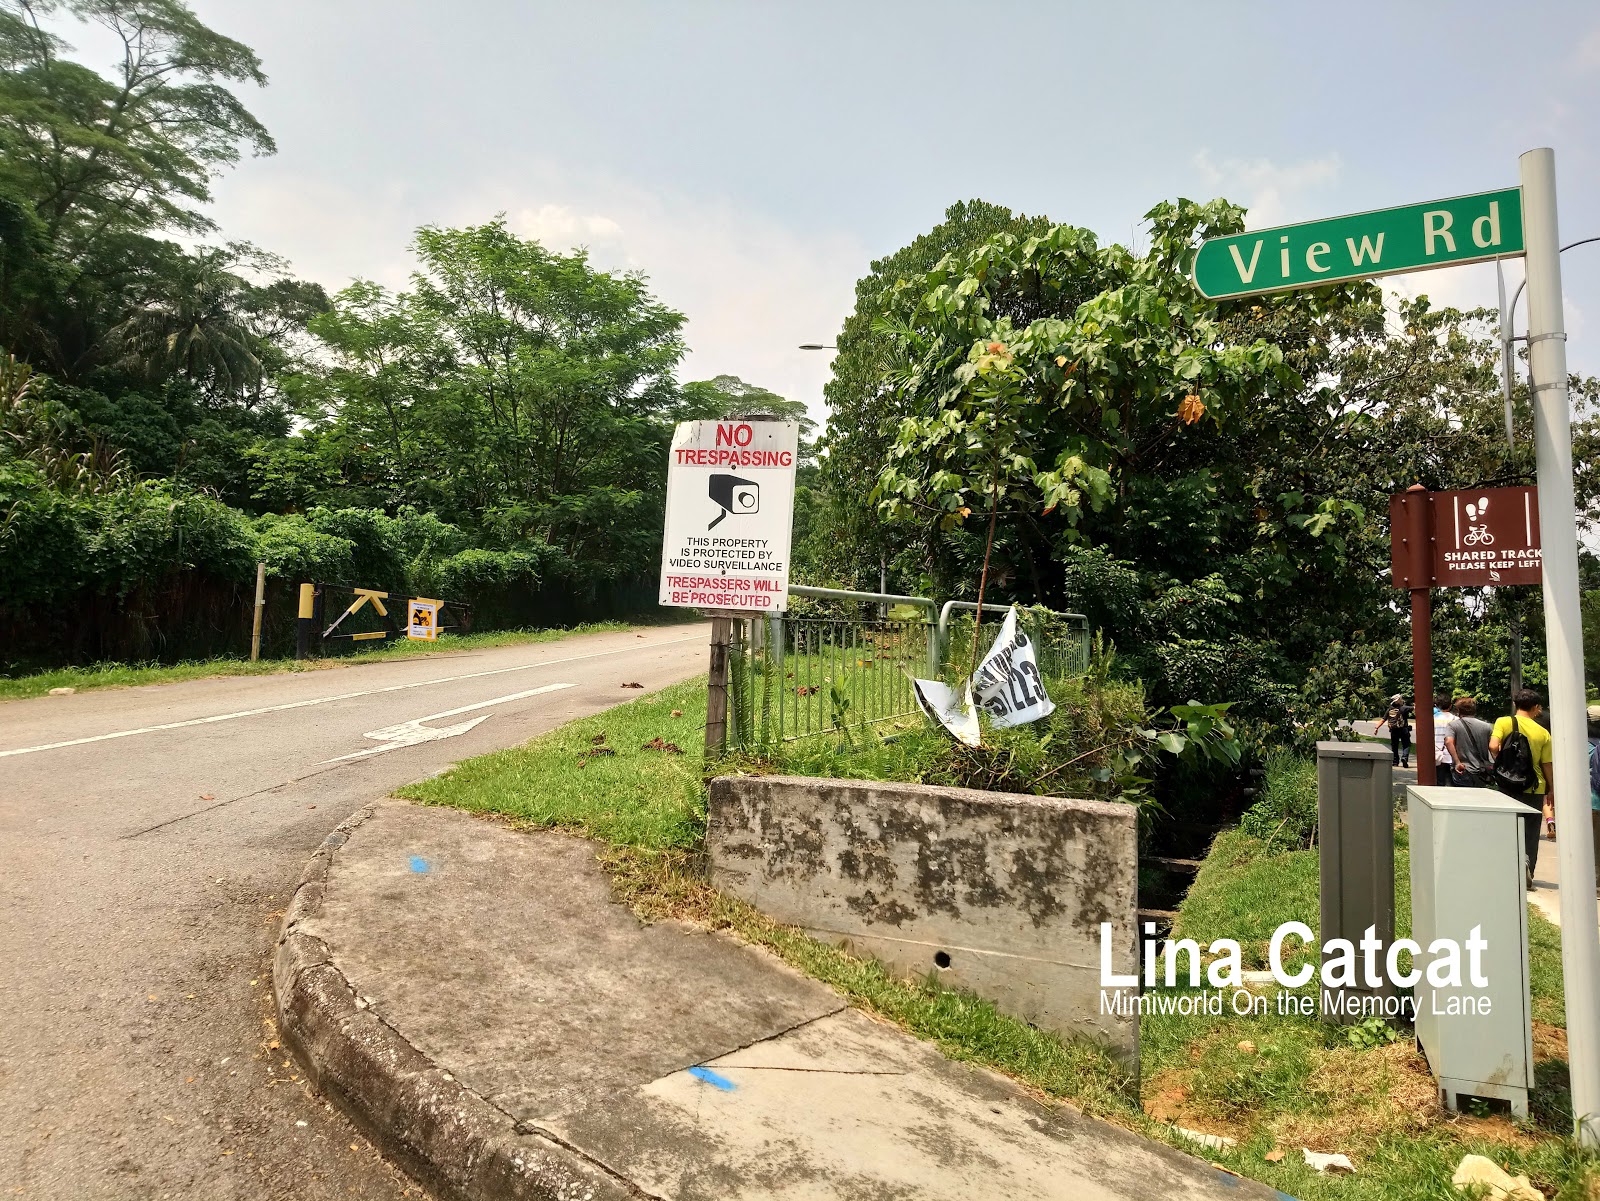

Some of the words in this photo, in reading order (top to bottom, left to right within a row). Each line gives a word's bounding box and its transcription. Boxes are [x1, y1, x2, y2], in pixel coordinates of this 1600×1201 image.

[1228, 231, 1385, 284] View
[1423, 200, 1501, 256] Rd
[716, 424, 753, 447] NO
[675, 449, 792, 467] TRESPASSING
[687, 537, 710, 547] THIS
[712, 538, 769, 549] PROPERTY
[680, 548, 691, 557] IS
[693, 549, 756, 559] PROTECTED
[758, 551, 773, 560] BY
[1444, 551, 1495, 561] SHARED
[1501, 549, 1542, 559] TRACK
[669, 558, 701, 568] VIDEO
[703, 560, 783, 572] SURVEILLANCE
[1449, 562, 1485, 570] PLEASE
[1489, 561, 1514, 569] KEEP
[1519, 560, 1540, 568] LEFT
[666, 576, 751, 592] TRESPASSERS
[753, 580, 783, 593] WILL
[672, 592, 689, 604] BE
[691, 592, 771, 608] PROSECUTED
